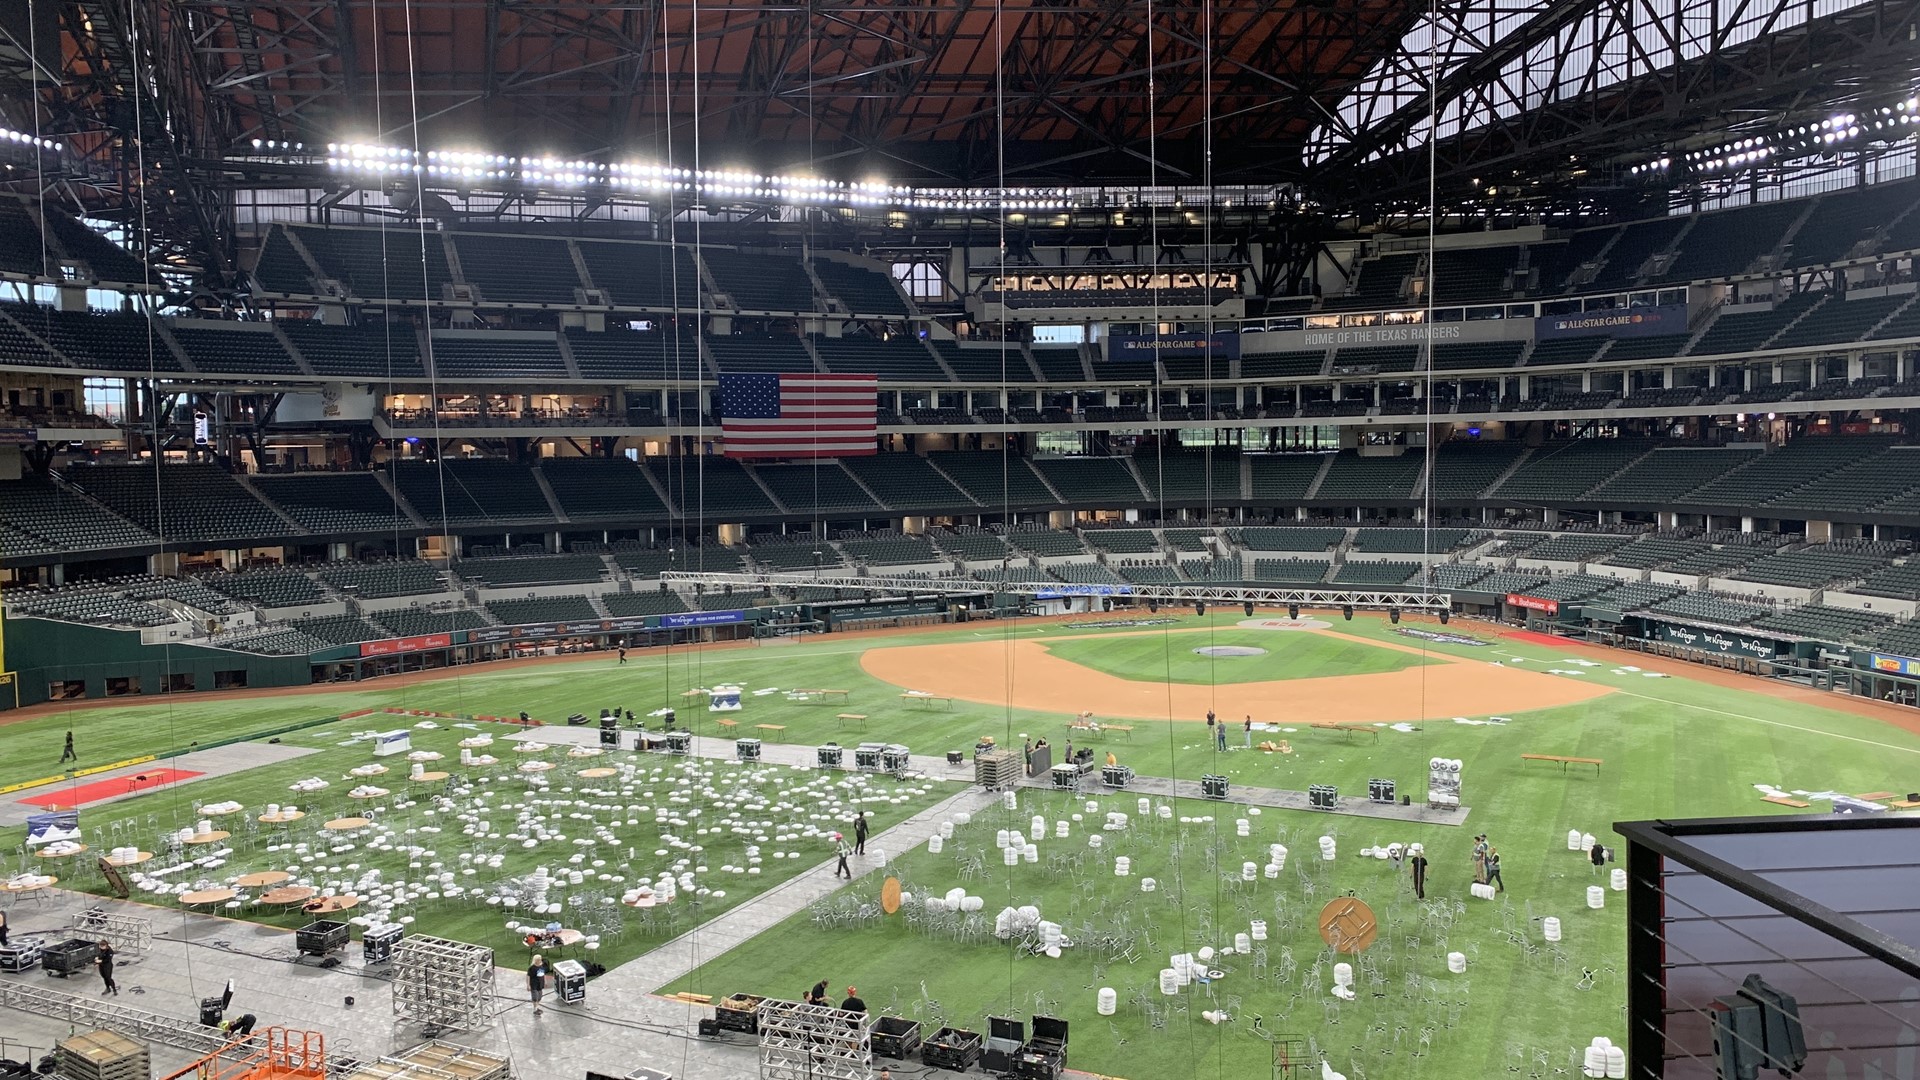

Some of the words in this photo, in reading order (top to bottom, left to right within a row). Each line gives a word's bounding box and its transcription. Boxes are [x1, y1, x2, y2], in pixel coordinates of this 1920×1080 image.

[1605, 316, 1631, 326] GAME
[1172, 340, 1196, 349] GAME
[1305, 333, 1334, 346] HOME
[1337, 332, 1350, 344] OF
[1353, 331, 1372, 343] THE
[1375, 329, 1408, 342] TEXAS
[1411, 326, 1460, 340] RANGERS
[1677, 627, 1697, 645] Kroger
[1712, 633, 1734, 651] Kroger
[1749, 640, 1772, 658] Kroger
